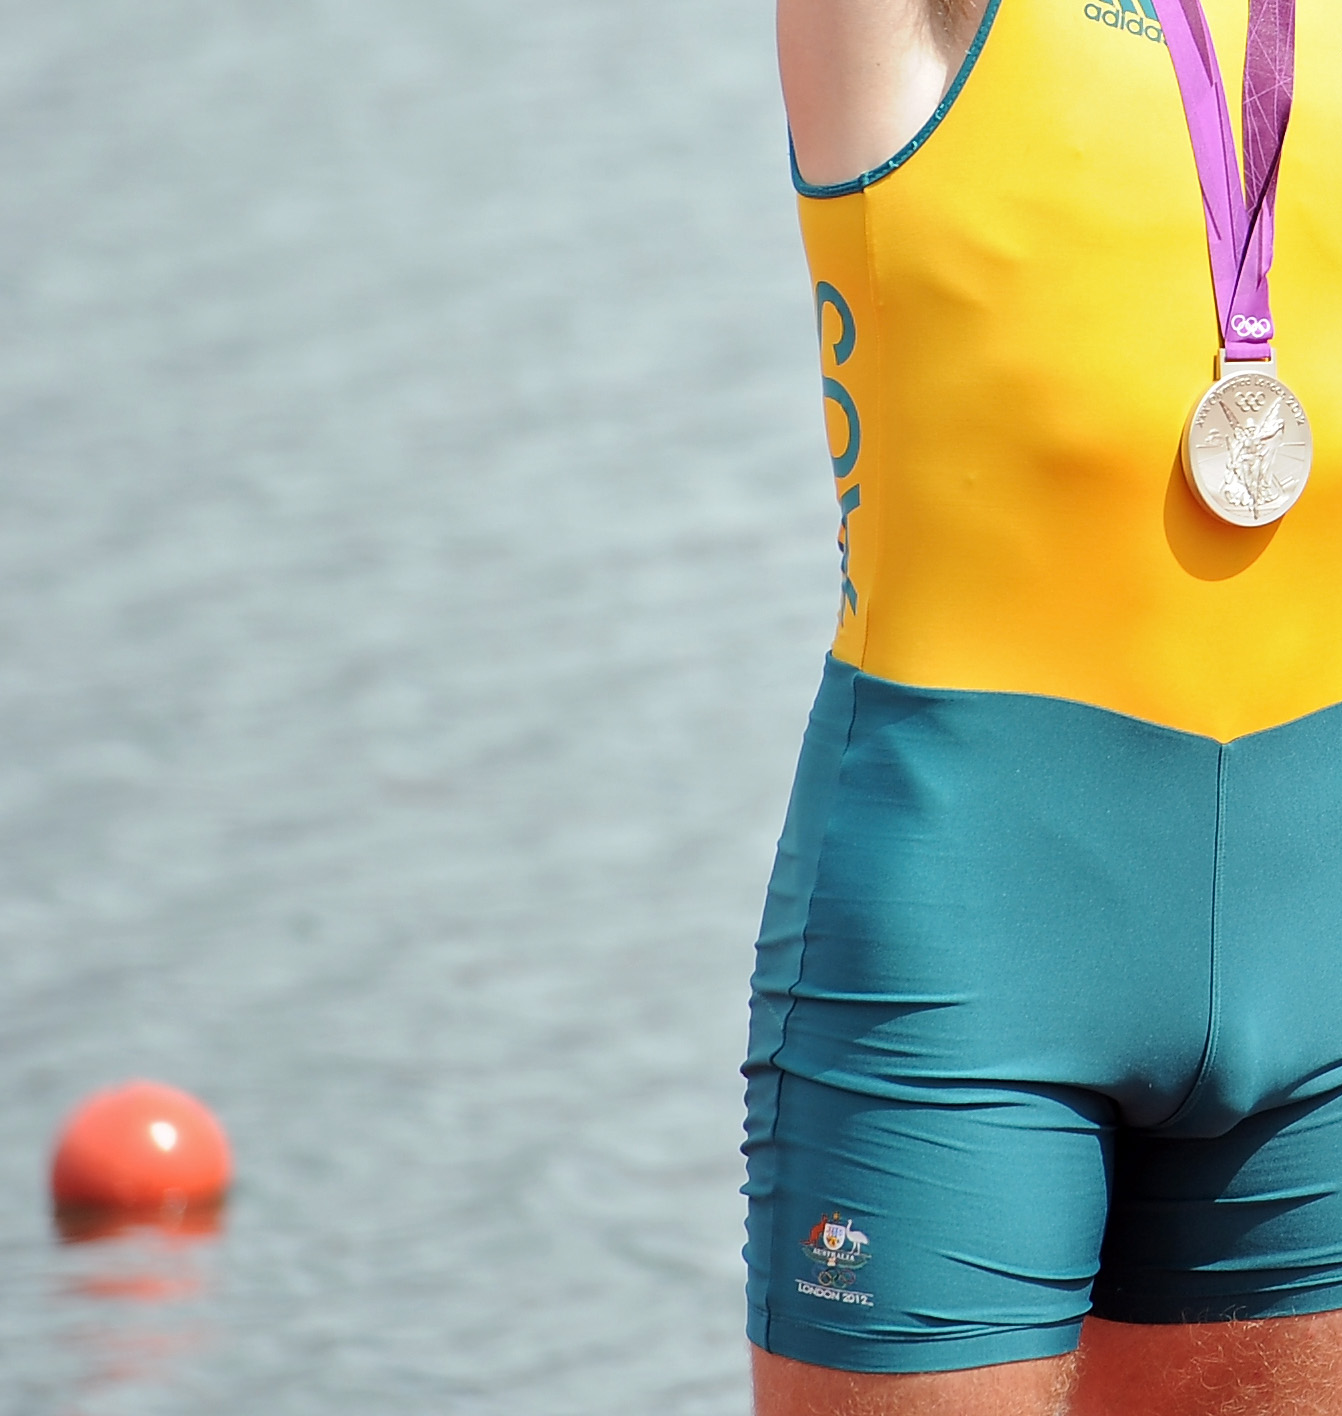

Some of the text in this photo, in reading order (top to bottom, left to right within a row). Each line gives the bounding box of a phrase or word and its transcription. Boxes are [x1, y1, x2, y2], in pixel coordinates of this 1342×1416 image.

[1084, 3, 1168, 46] adida
[798, 1282, 868, 1305] LONDON 2012
